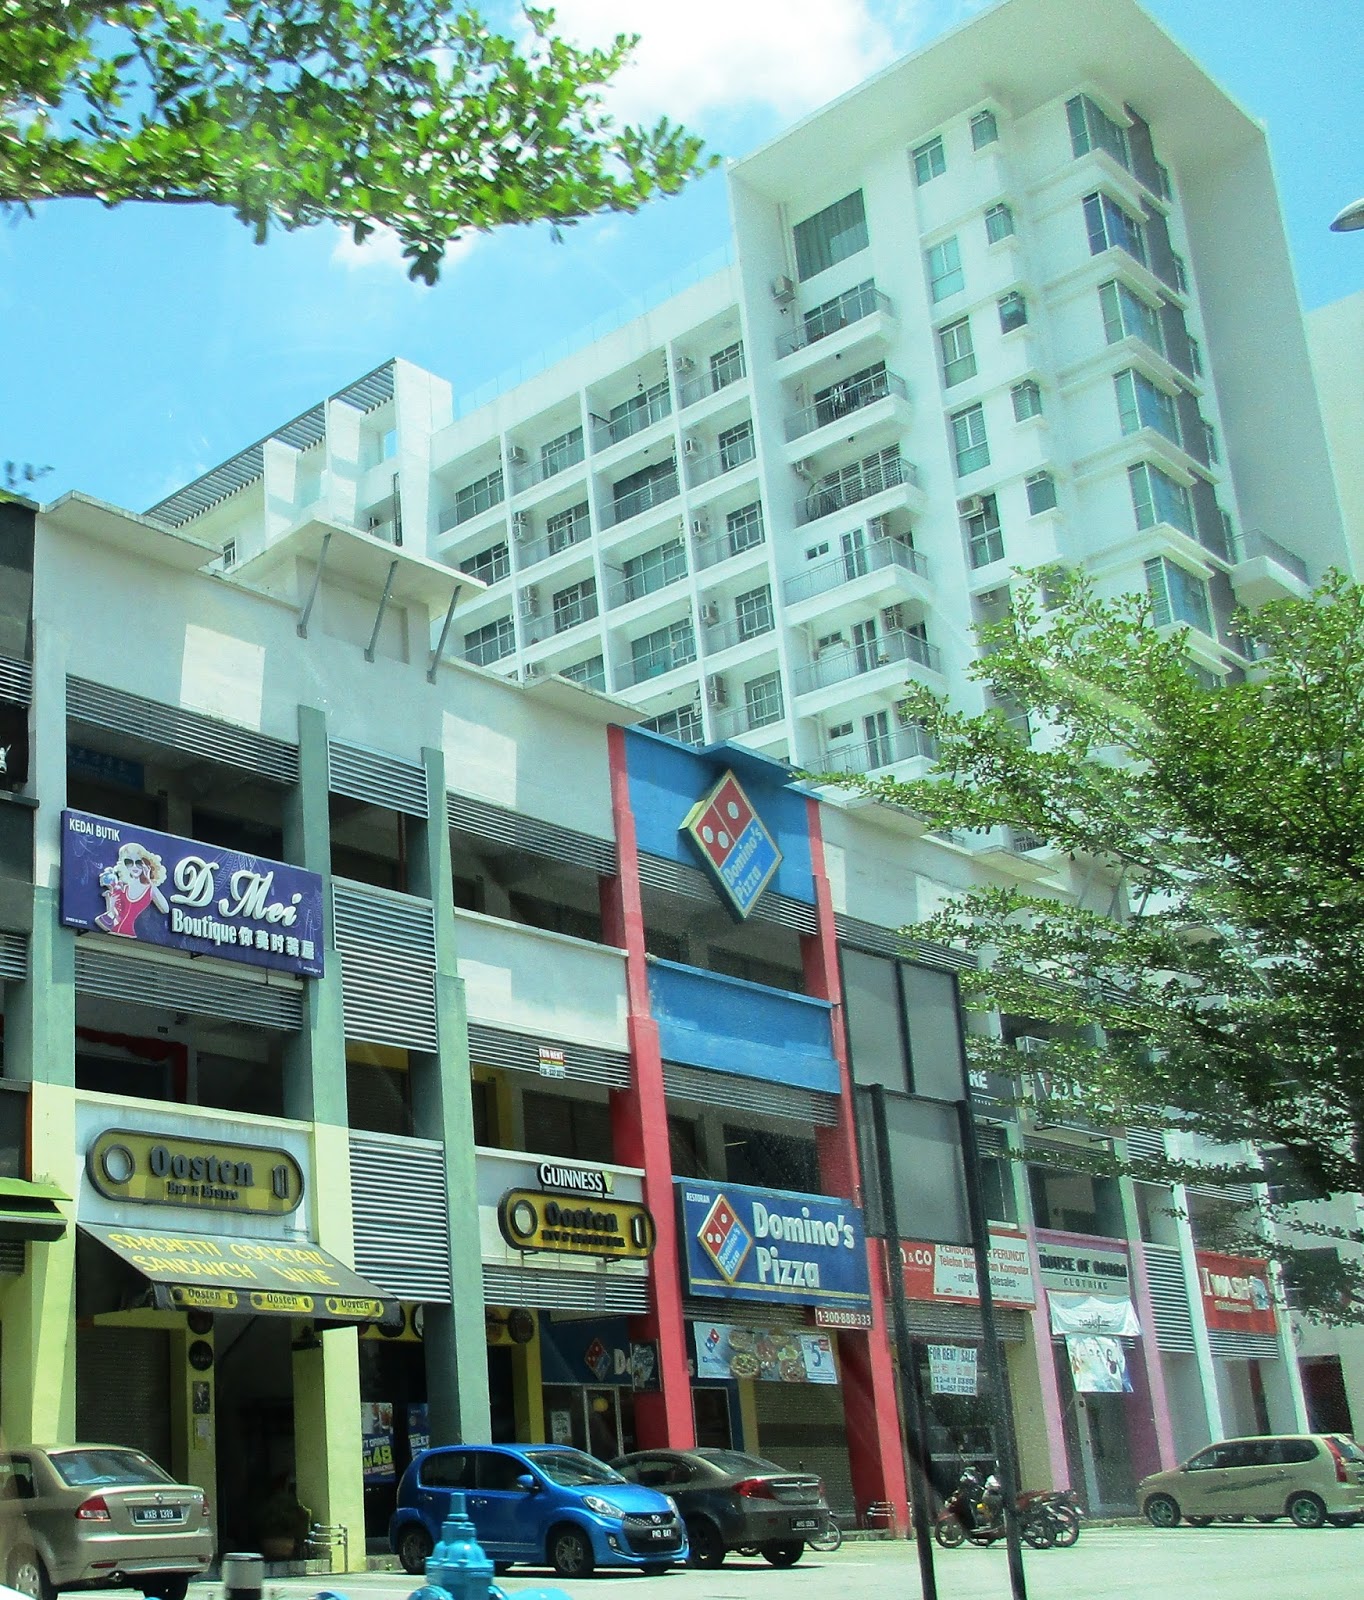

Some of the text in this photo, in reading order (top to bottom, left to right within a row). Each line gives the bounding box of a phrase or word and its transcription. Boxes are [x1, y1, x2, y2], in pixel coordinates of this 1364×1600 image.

[69, 818, 120, 842] KEDAI BUTIK
[723, 826, 763, 887] Domino's
[170, 856, 302, 926] D Mei
[734, 865, 762, 905] Pizza
[172, 908, 237, 946] Boutique
[151, 1145, 255, 1187] Oosten
[540, 1163, 603, 1192] GUINNESS
[686, 1192, 710, 1204] RESTORAN
[545, 1201, 618, 1233] Oosten
[752, 1202, 855, 1249] Domino's
[228, 1243, 334, 1268] COCKTAIL
[718, 1226, 742, 1265] Domino's
[915, 1249, 932, 1266] CO
[131, 1255, 340, 1287] SANDWICH WINE
[725, 1249, 741, 1275] Pizza
[755, 1246, 820, 1288] Pizza
[188, 1288, 370, 1310] Oosten Oosten Oosten
[1063, 1277, 1108, 1290] CLOTHING
